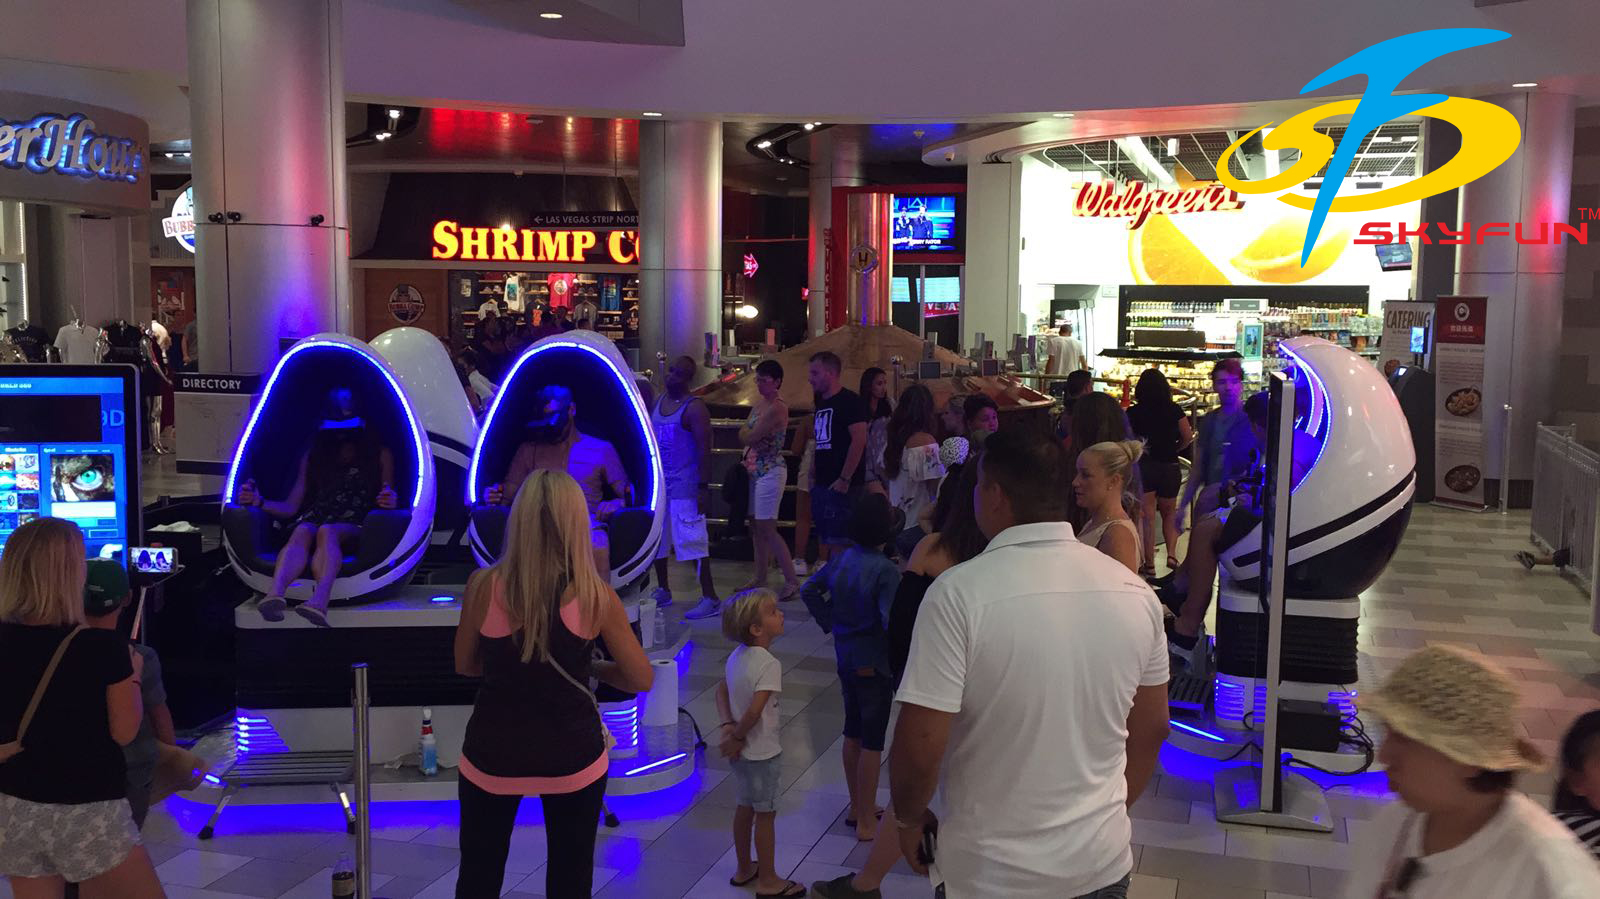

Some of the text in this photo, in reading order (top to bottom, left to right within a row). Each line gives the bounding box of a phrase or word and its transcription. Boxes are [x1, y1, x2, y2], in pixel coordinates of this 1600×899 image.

[40, 119, 142, 175] Hou
[545, 215, 639, 224] LAS VEGAS STRIP NORT
[1071, 179, 1246, 230] Walgreens
[432, 220, 639, 263] SHRIMP C
[1386, 310, 1430, 328] CATERING
[182, 378, 241, 389] DIRECTORY
